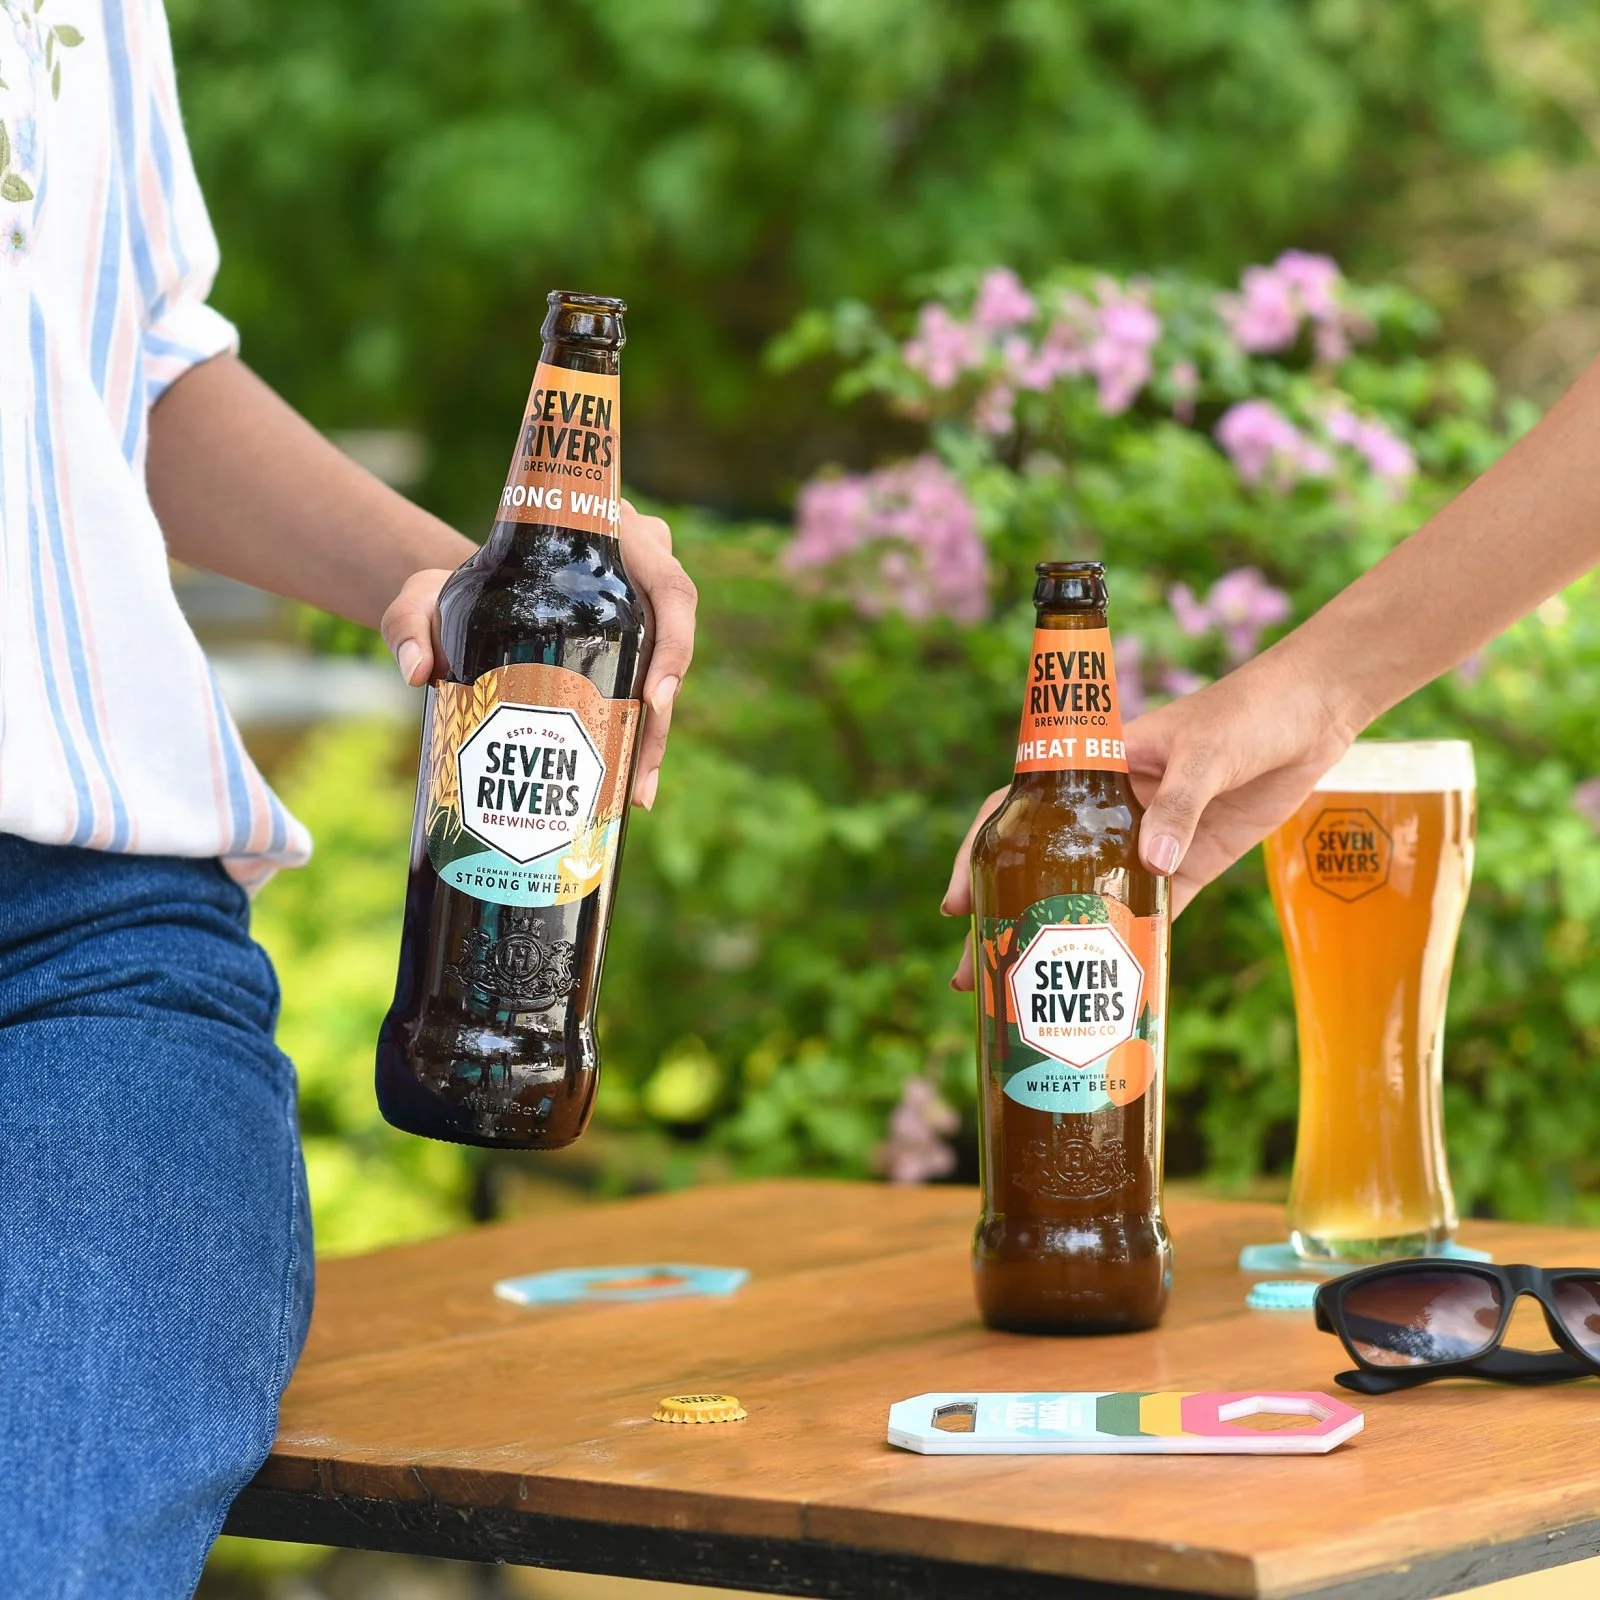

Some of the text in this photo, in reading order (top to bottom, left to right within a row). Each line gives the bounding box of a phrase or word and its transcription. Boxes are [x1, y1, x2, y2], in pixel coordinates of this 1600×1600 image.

[530, 389, 613, 431] SEVEN
[522, 424, 613, 467] RIVERS
[524, 460, 604, 481] BREWING CO.
[503, 485, 563, 511] RONG
[1034, 651, 1106, 683] SEVEN
[1030, 683, 1112, 715] RIVERS
[1034, 715, 1108, 728] BREWING CO.
[506, 727, 565, 744] ESTD. 2020
[1085, 738, 1127, 761] BEER
[485, 741, 578, 781] SEVEN
[476, 776, 580, 817] RIVERS
[482, 813, 570, 832] BREWING CO.
[1317, 830, 1375, 852] SEVEN
[476, 866, 563, 881] GERMAN HEFEWEIZEN
[1316, 852, 1380, 874] RIVERS
[455, 872, 580, 894] STRONG WHEAT
[1051, 943, 1105, 957] ESTD. 2020
[1034, 959, 1118, 991] SEVEN
[1031, 991, 1125, 1024] RIVERS
[1038, 1025, 1119, 1037] BREWING CO.
[1026, 1079, 1127, 1093] WHEAT BEER
